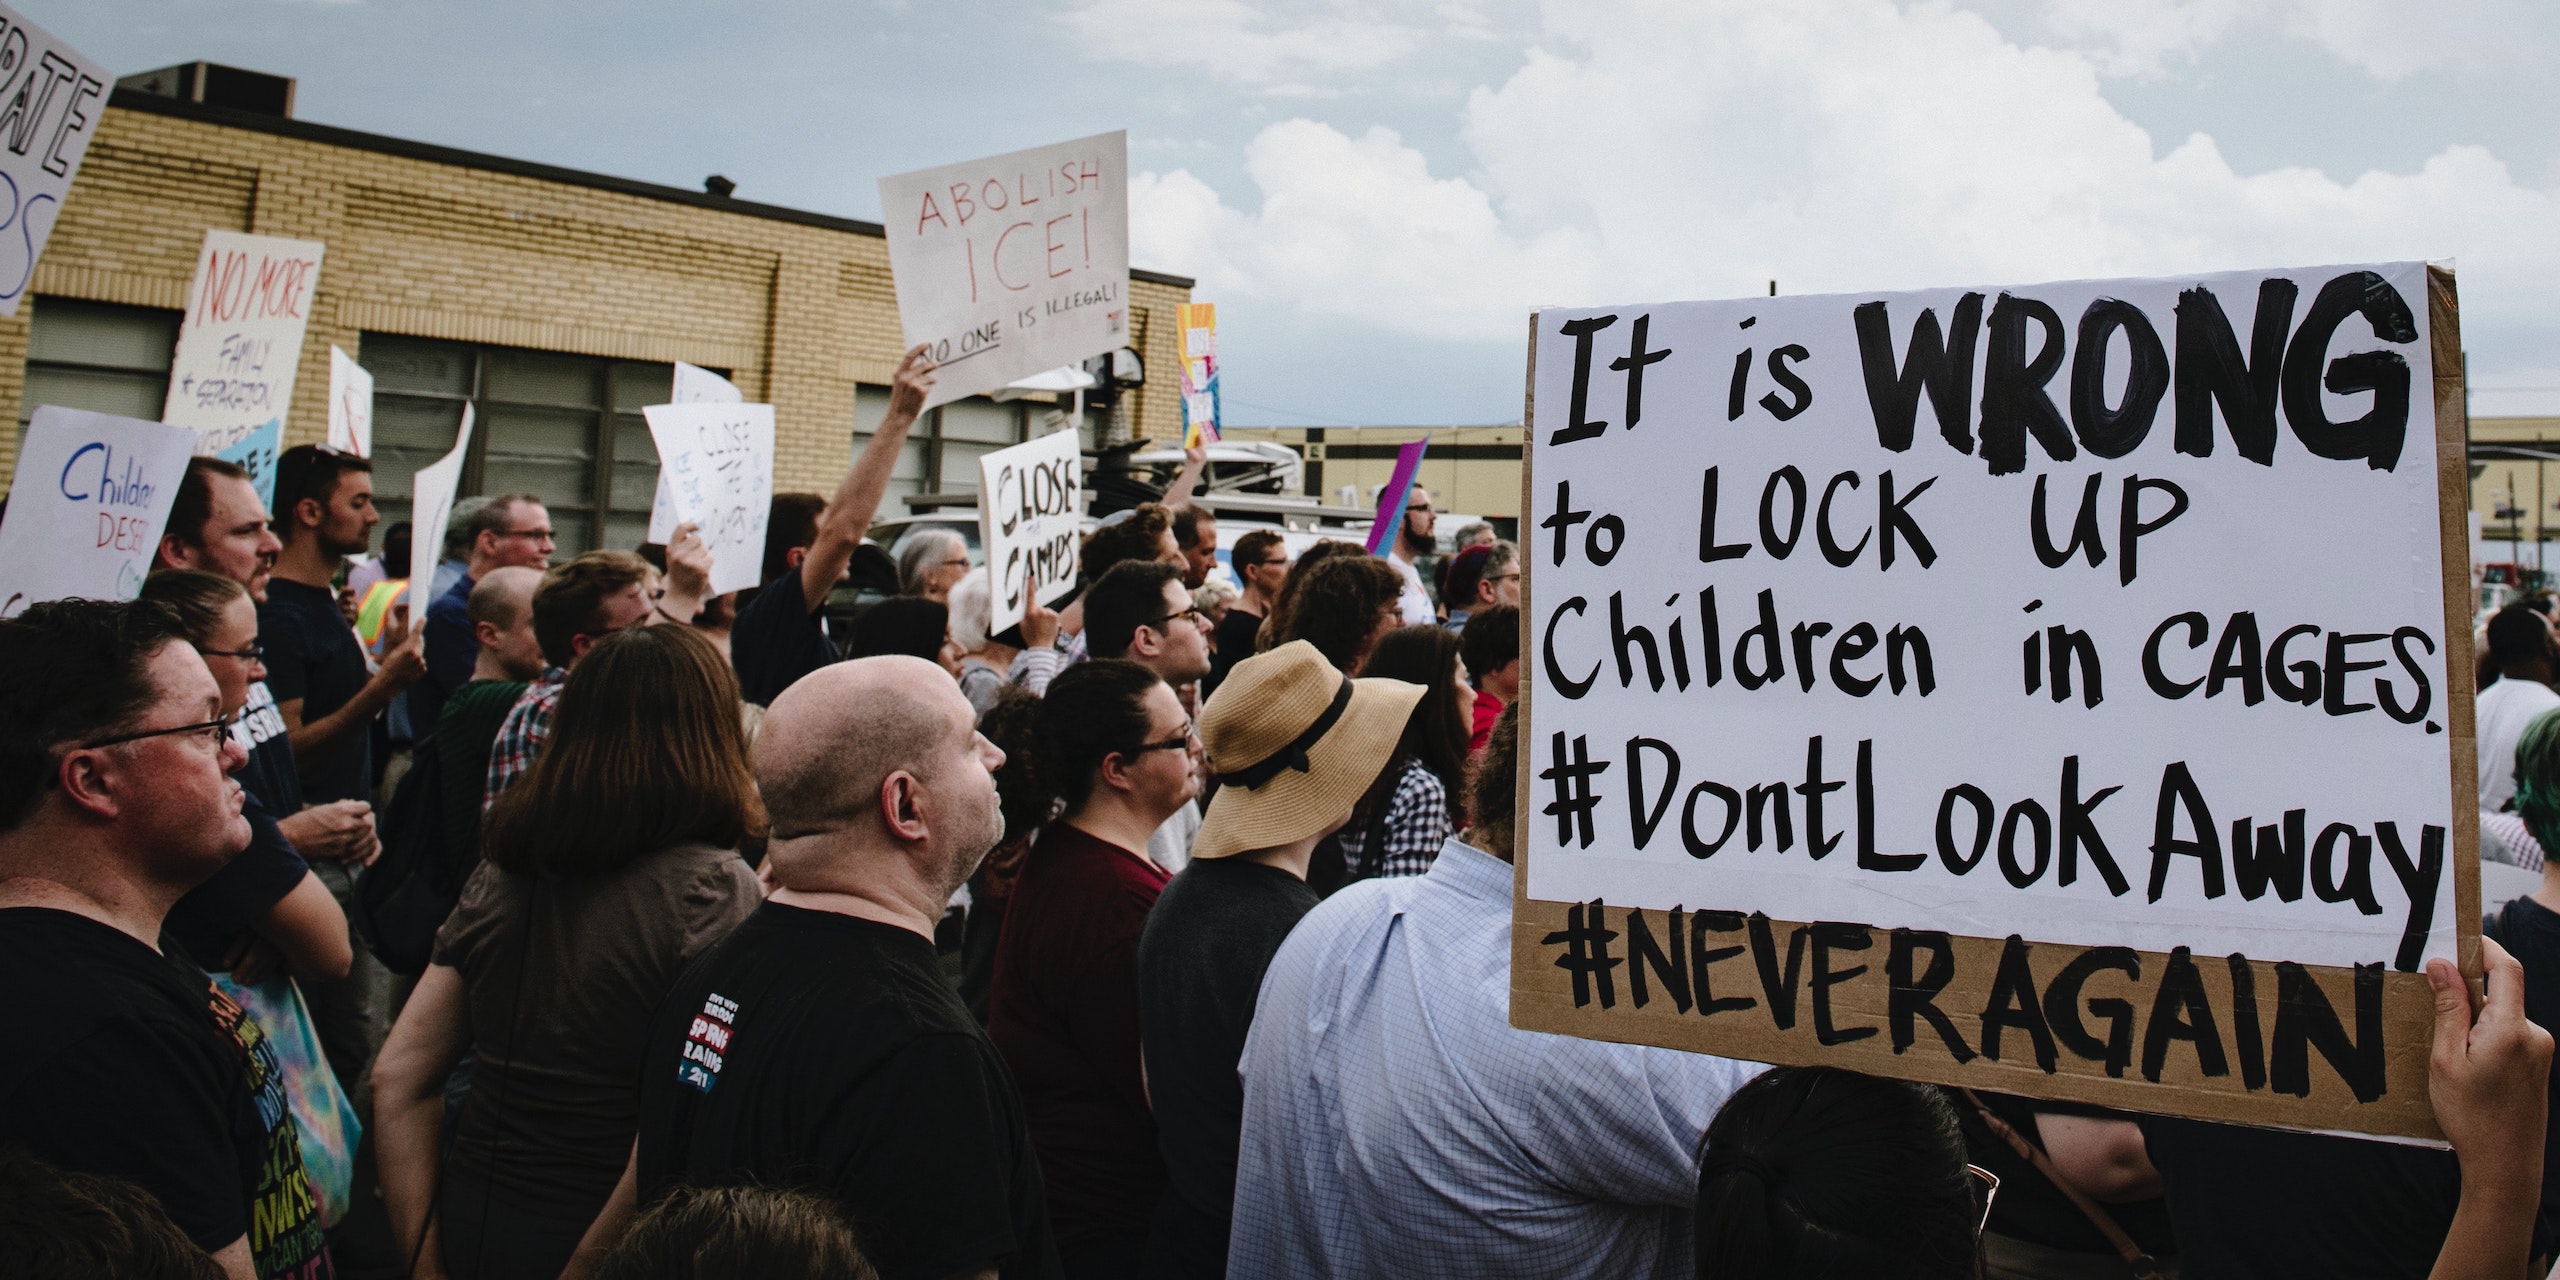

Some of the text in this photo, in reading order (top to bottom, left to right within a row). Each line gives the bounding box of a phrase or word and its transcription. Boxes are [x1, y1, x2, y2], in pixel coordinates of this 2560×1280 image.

[917, 157, 1101, 236] ABOLISH
[196, 250, 316, 328] NO MORE
[966, 207, 1091, 303] ICE!
[960, 319, 1001, 353] ONE
[1017, 305, 1037, 330] IS
[1548, 270, 2419, 477] It is WRONG
[997, 457, 1078, 538] CLOSE
[1540, 464, 2190, 588] to LOCK UP
[1003, 529, 1074, 612] CAMPS
[1543, 584, 2442, 735] Children in CAGES.
[1540, 897, 2388, 1104] #NEVERAGAIN
